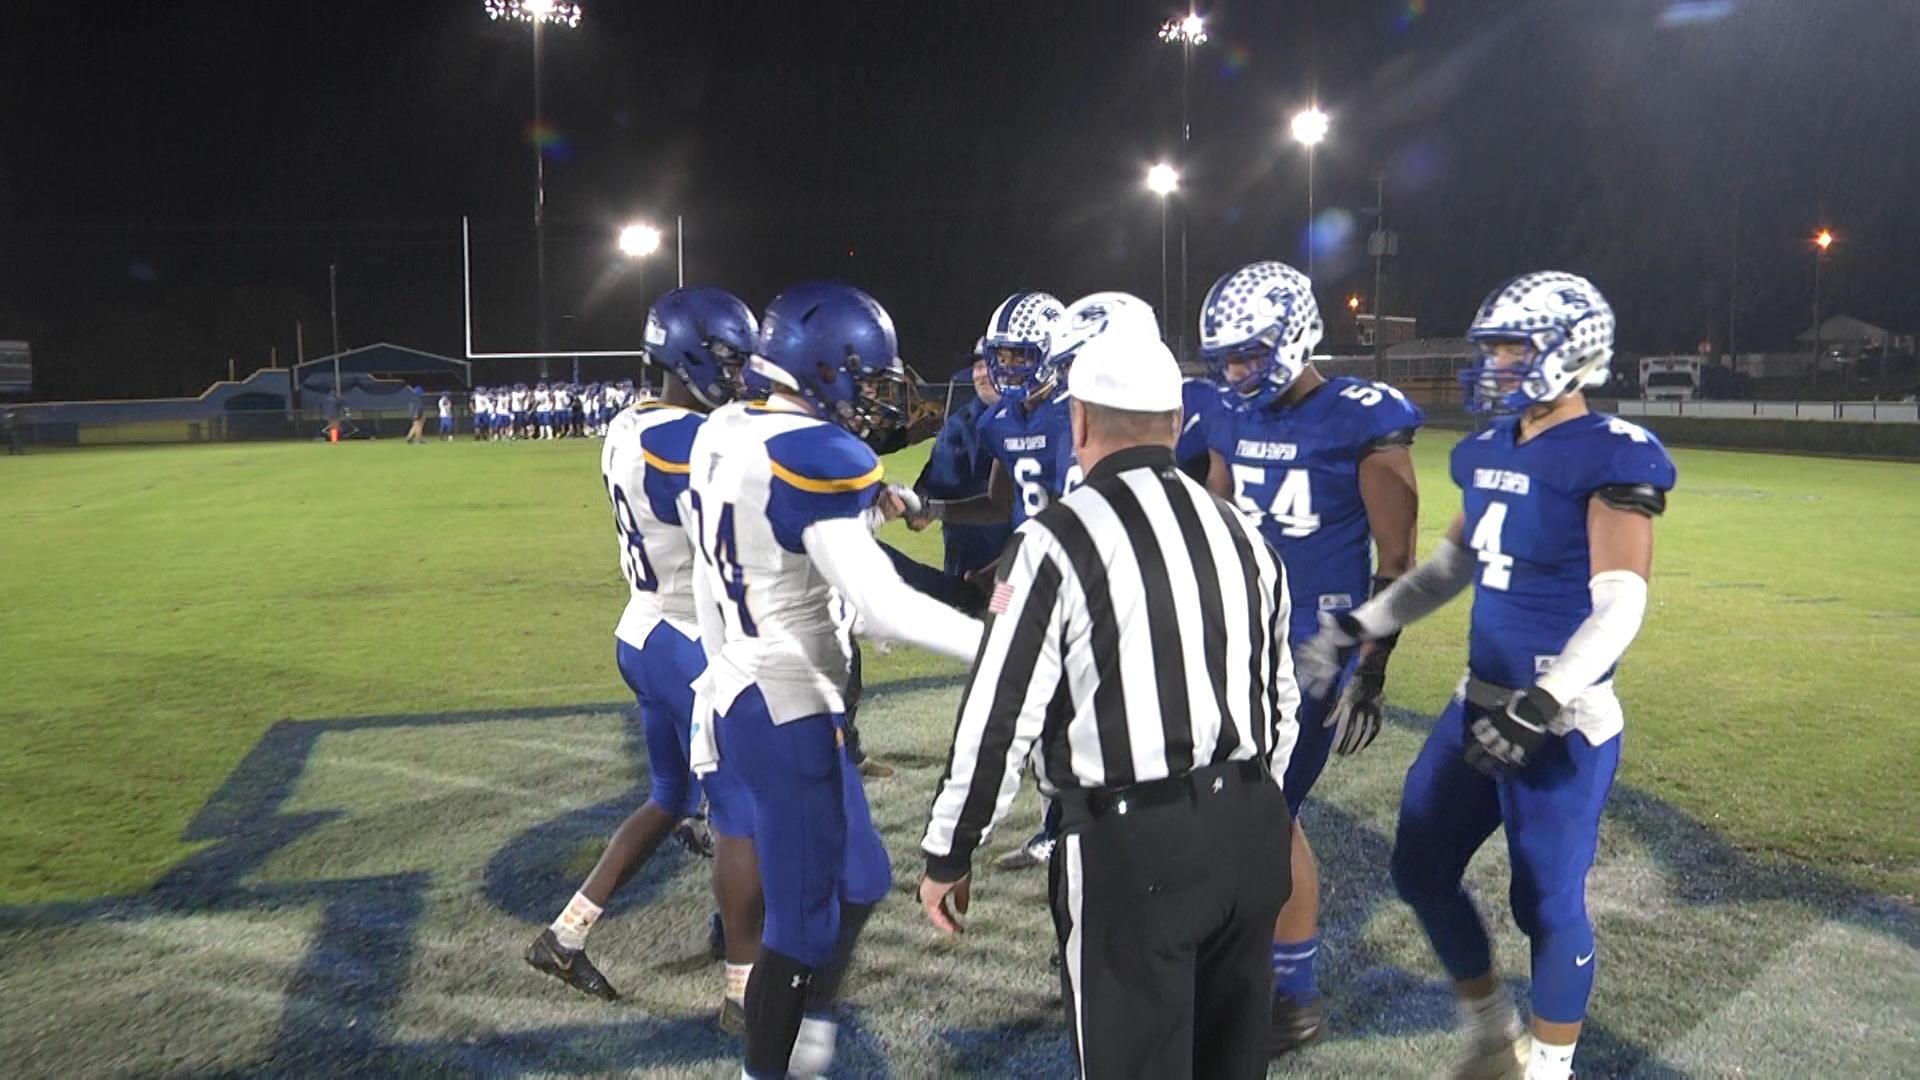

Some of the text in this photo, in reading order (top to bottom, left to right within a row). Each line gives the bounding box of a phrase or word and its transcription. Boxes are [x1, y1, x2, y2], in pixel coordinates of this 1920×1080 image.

[1014, 457, 1049, 516] 6
[1231, 462, 1321, 538] 54
[1470, 501, 1515, 591] 4
